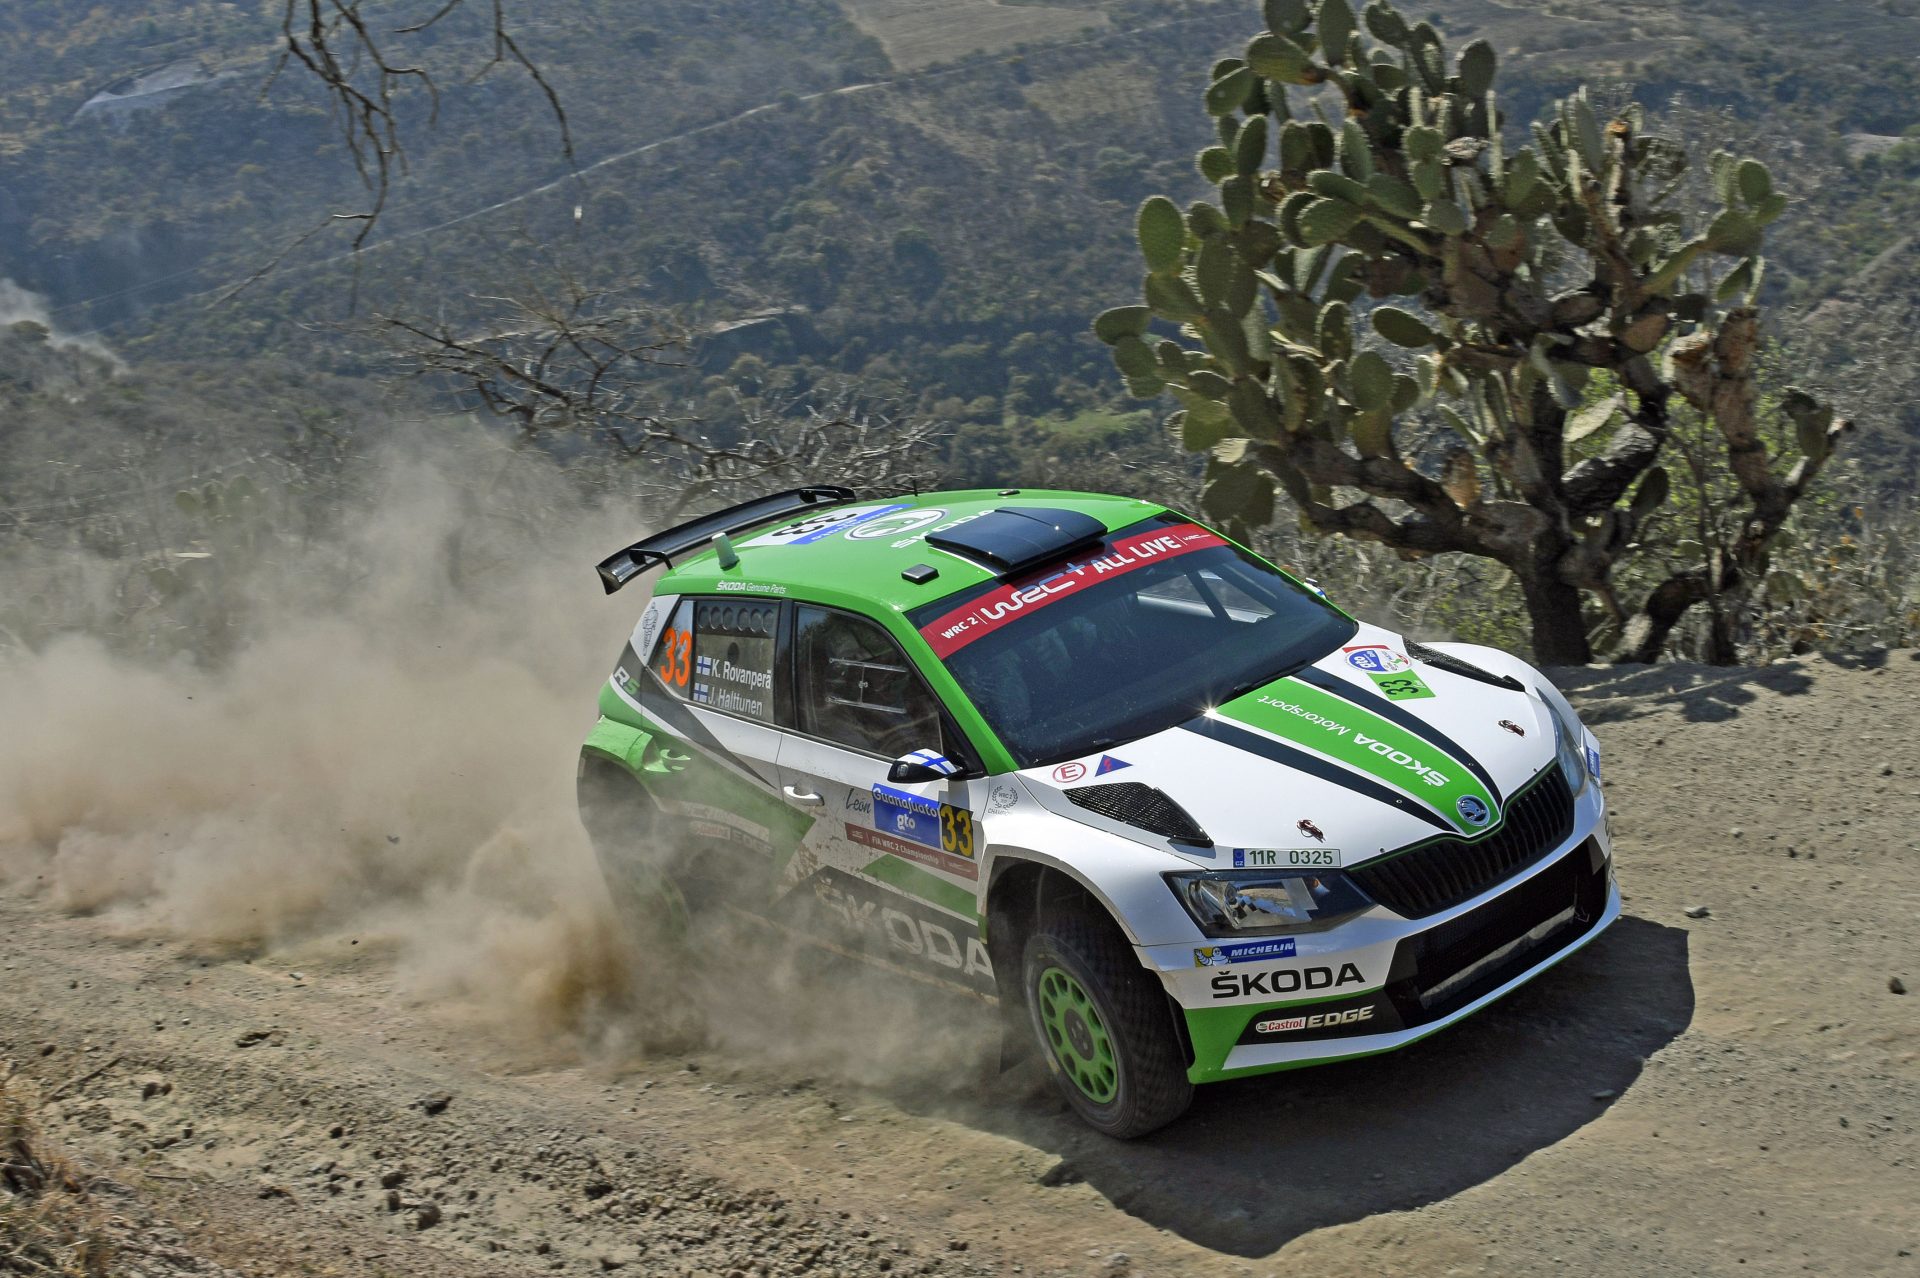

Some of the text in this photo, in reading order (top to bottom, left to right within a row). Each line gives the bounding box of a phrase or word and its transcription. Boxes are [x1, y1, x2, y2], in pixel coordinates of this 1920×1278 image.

[1090, 552, 1136, 574] ALL
[1128, 536, 1182, 558] LIVE
[746, 582, 770, 593] Genuine
[769, 583, 787, 595] Parts
[941, 616, 979, 639] WRC 2
[660, 627, 692, 688] 33
[711, 658, 772, 691] K. Rovanperä
[708, 685, 716, 705] J.
[1378, 679, 1420, 696] 33
[1256, 695, 1451, 787] ŠKODA Motorsport
[1060, 764, 1079, 780] E
[872, 787, 938, 818] Guanajuato
[897, 813, 916, 831] gto
[940, 804, 974, 858] 33
[900, 846, 940, 864] Championship
[1249, 850, 1277, 865] 11R
[1289, 850, 1333, 865] 0325
[1230, 941, 1295, 957] MICHELIN
[1211, 961, 1366, 999] ŠKODA
[1267, 1004, 1376, 1032] Castrol EDGE
